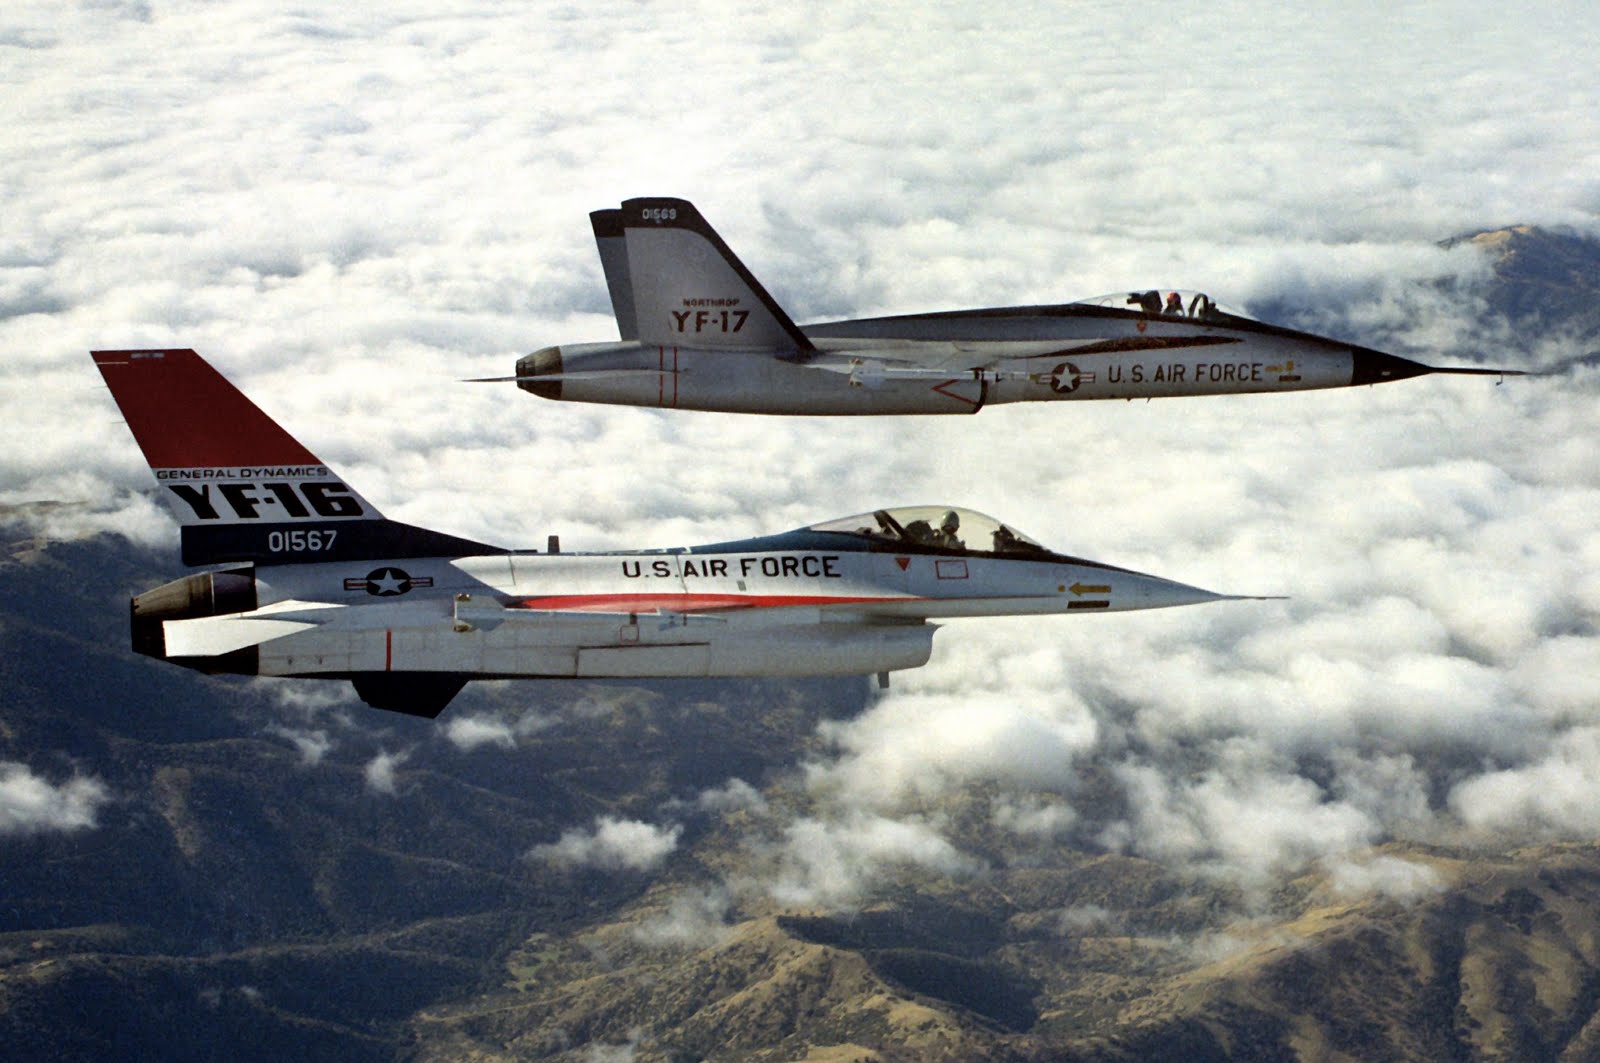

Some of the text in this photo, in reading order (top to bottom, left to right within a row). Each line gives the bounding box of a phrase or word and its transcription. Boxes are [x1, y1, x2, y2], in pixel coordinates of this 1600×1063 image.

[642, 208, 677, 220] 01569
[683, 298, 740, 307] NORTHROP
[671, 310, 750, 333] YF-17
[1108, 362, 1263, 383] U.S. AIR FORCE
[156, 466, 328, 480] GENERAL DYNAMICS
[168, 482, 364, 519] YF-16
[268, 530, 338, 552] 01567
[622, 555, 842, 578] U.S. AIR FORCE
